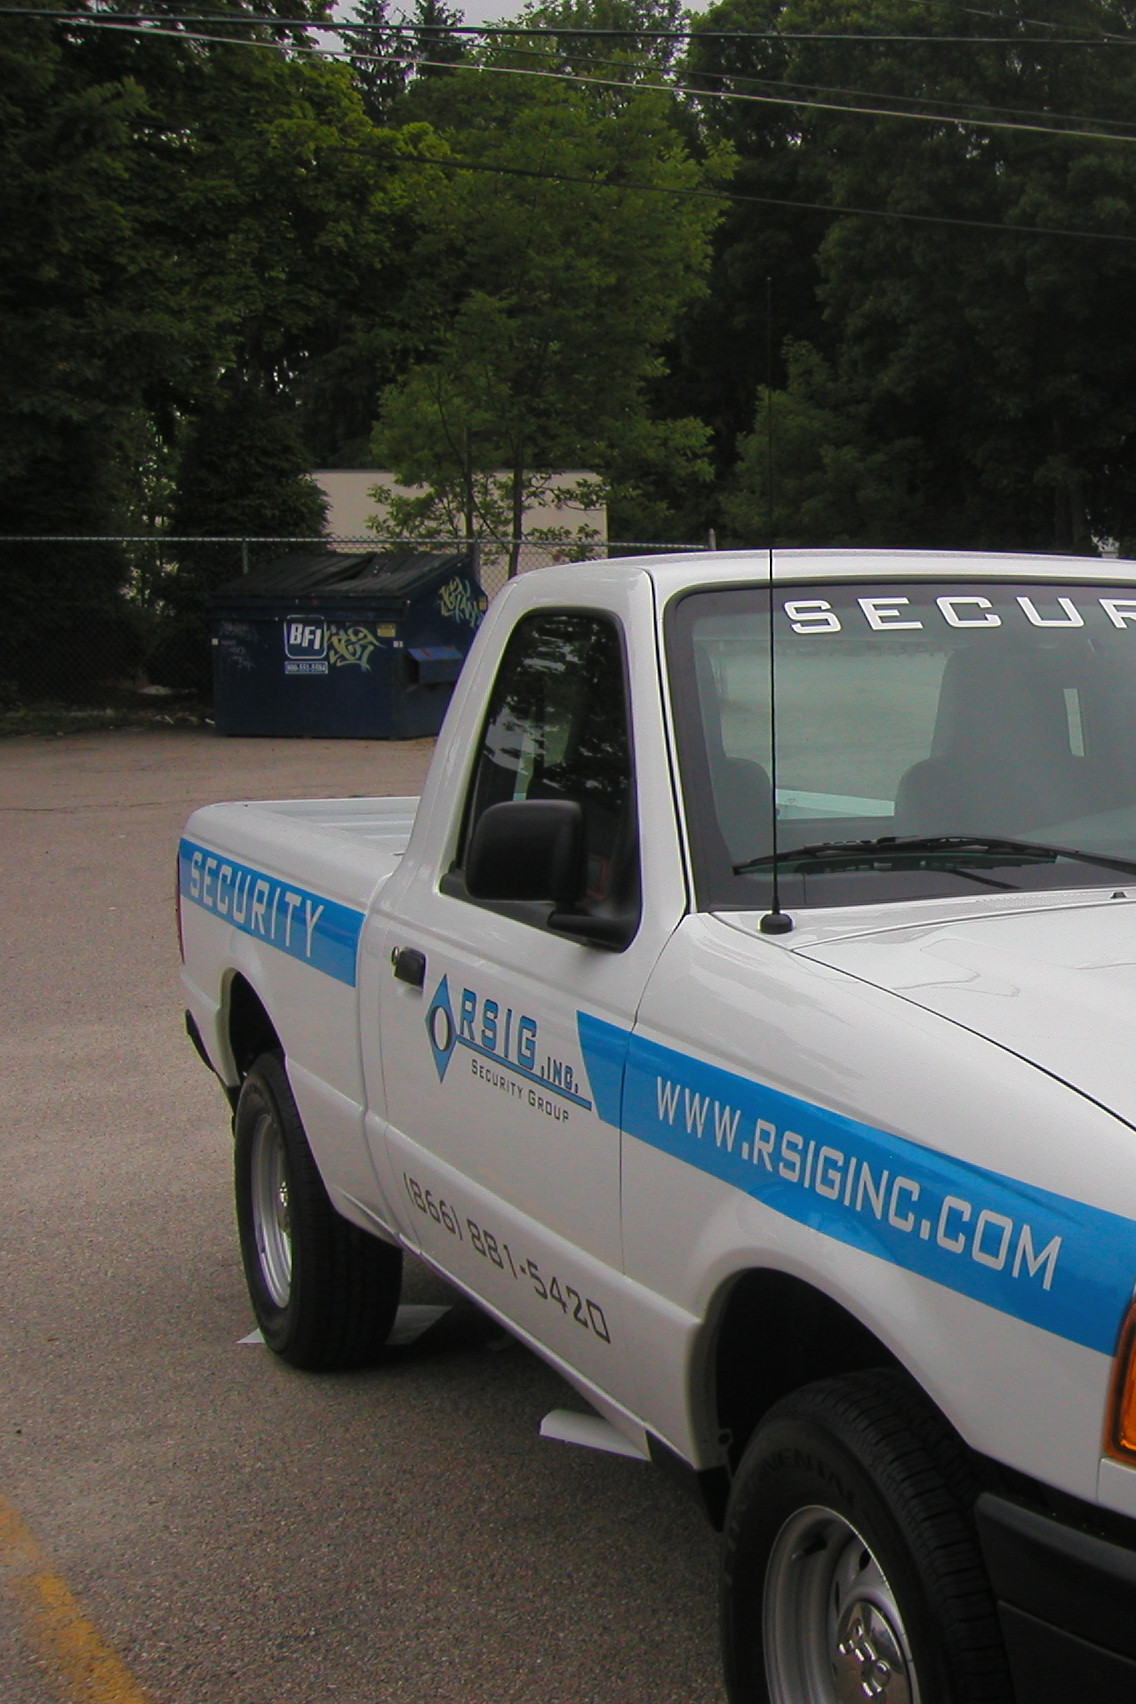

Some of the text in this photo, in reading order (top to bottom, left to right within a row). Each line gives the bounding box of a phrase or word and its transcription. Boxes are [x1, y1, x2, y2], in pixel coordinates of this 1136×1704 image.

[290, 623, 322, 650] BFI
[189, 851, 325, 958] SECURITY
[403, 1171, 464, 1241] (866)
[655, 1075, 1063, 1291] WWW.RSIGINC.COM
